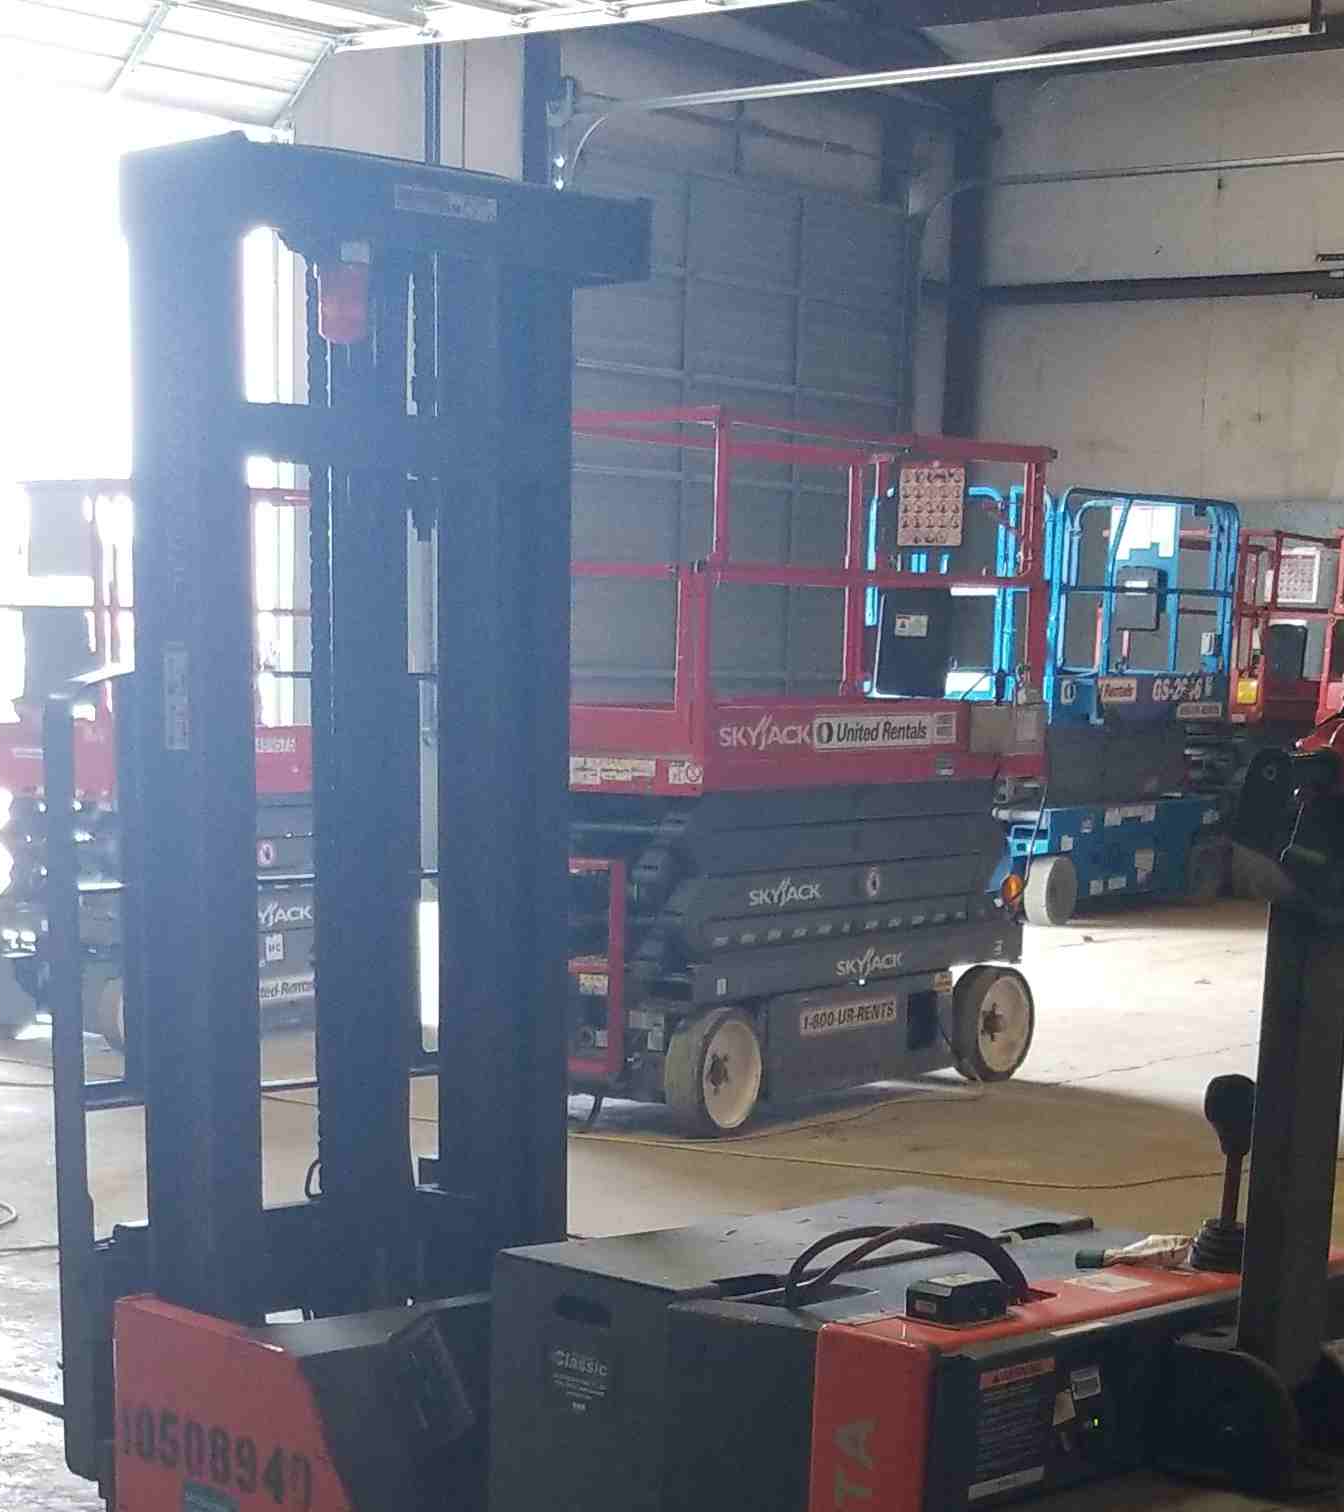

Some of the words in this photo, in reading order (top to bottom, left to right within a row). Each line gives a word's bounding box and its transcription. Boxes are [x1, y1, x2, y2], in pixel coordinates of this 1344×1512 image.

[719, 713, 812, 750] SKYJACK
[836, 722, 879, 744] United
[883, 719, 927, 741] Rentals
[749, 876, 823, 906] SKYJACK
[257, 903, 312, 927] YJACK
[836, 947, 903, 976] SKYJACK
